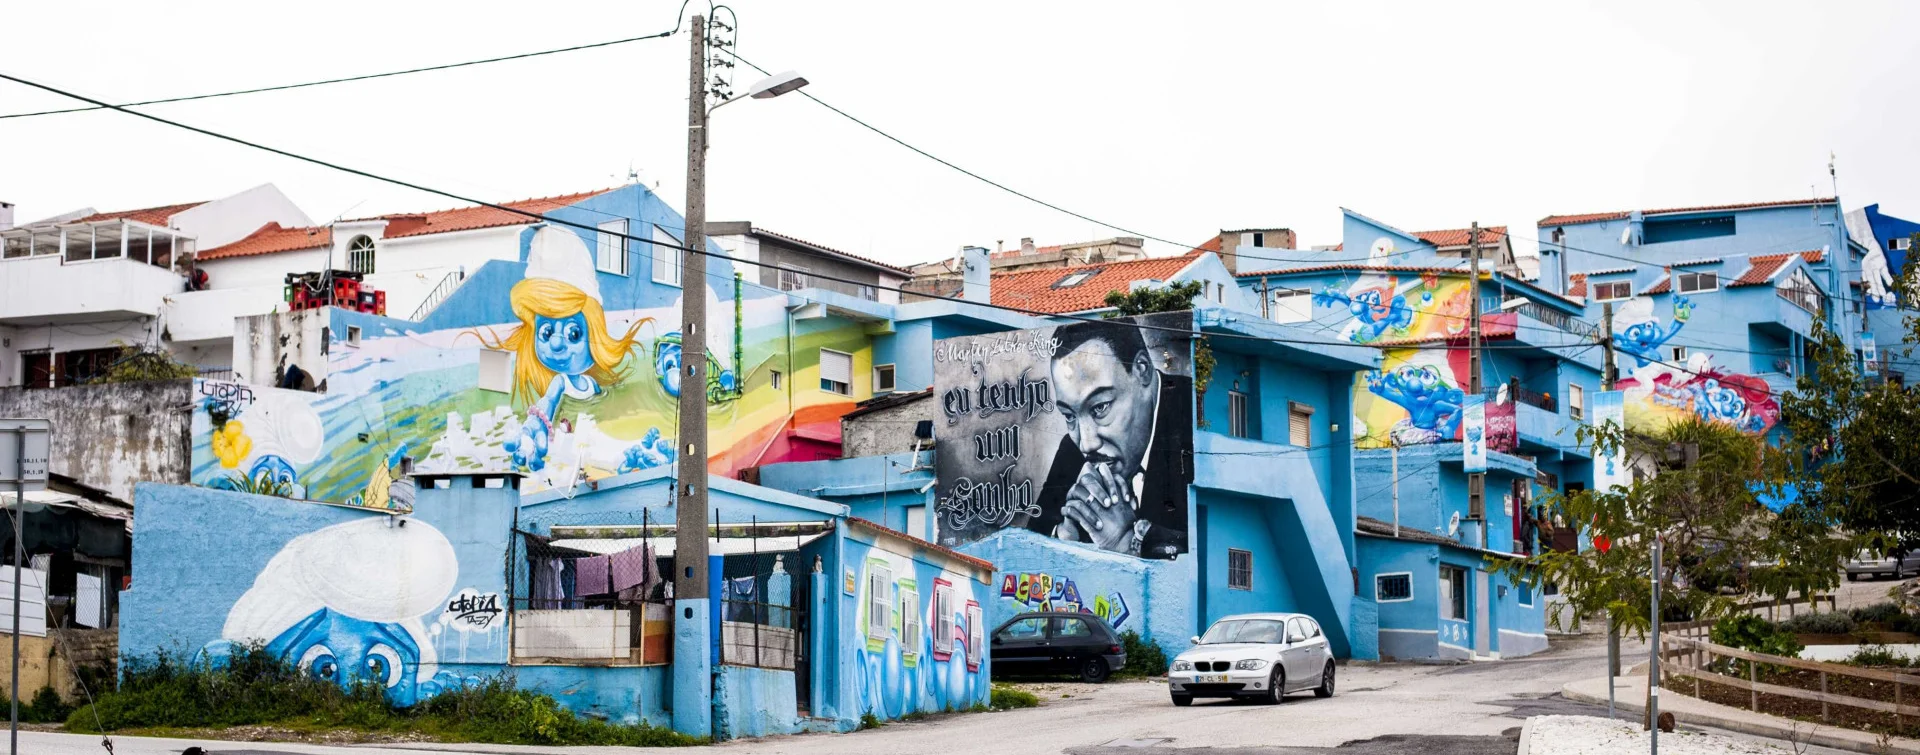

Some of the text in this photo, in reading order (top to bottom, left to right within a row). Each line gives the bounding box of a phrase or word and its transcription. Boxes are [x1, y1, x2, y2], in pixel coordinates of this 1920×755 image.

[937, 329, 1063, 366] Martin Luther King
[944, 365, 1054, 426] eu tenho
[975, 424, 1020, 462] um
[1471, 443, 1478, 455] 2
[1605, 460, 1614, 476] 2
